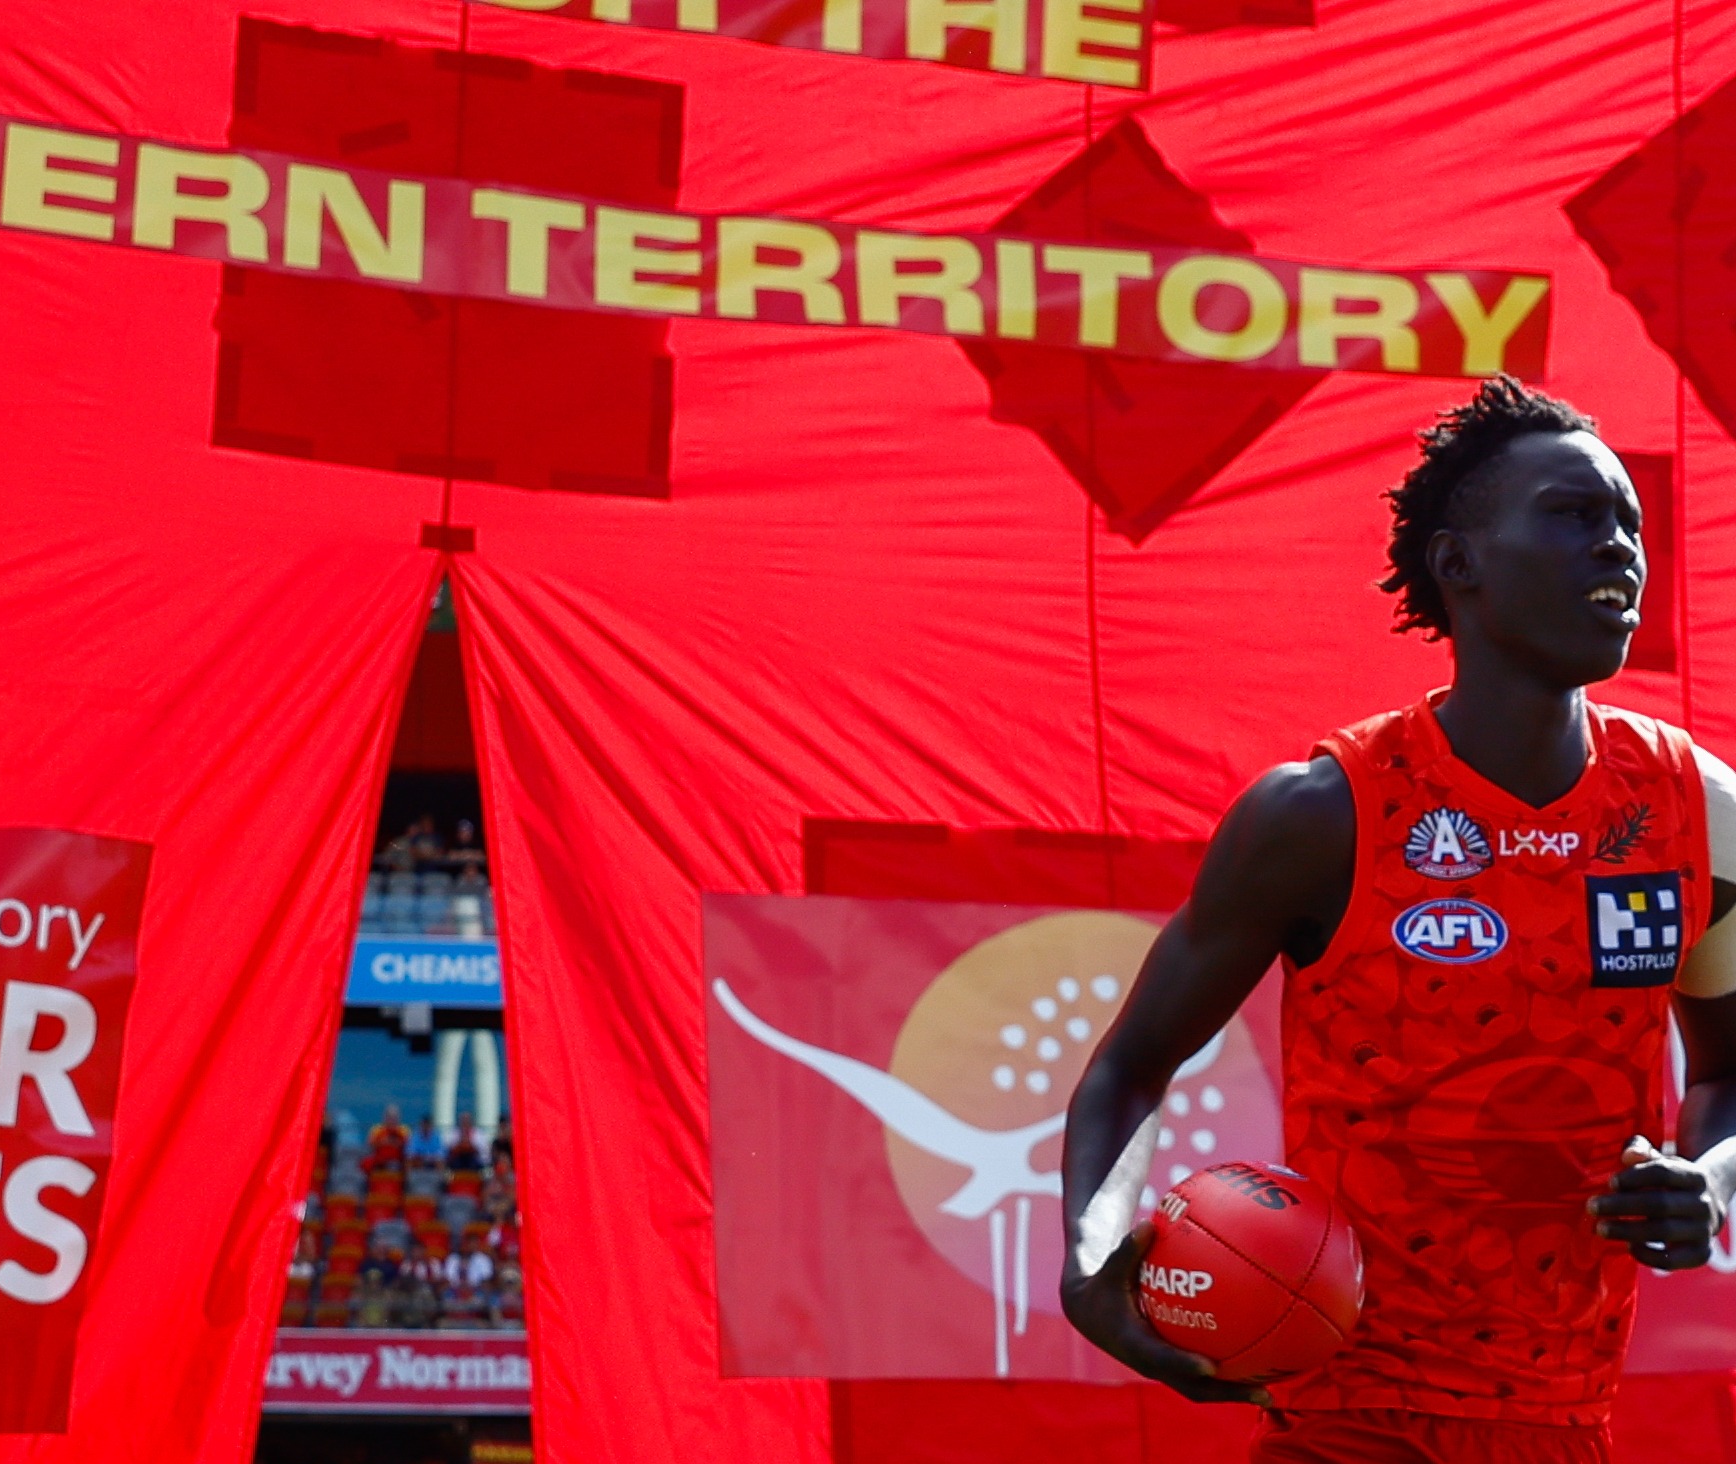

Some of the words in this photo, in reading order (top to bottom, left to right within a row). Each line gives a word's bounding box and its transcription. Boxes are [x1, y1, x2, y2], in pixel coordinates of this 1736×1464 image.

[472, 187, 1550, 377] TERRITORY
[1405, 913, 1499, 947] AFL
[1140, 1260, 1213, 1299] HARP
